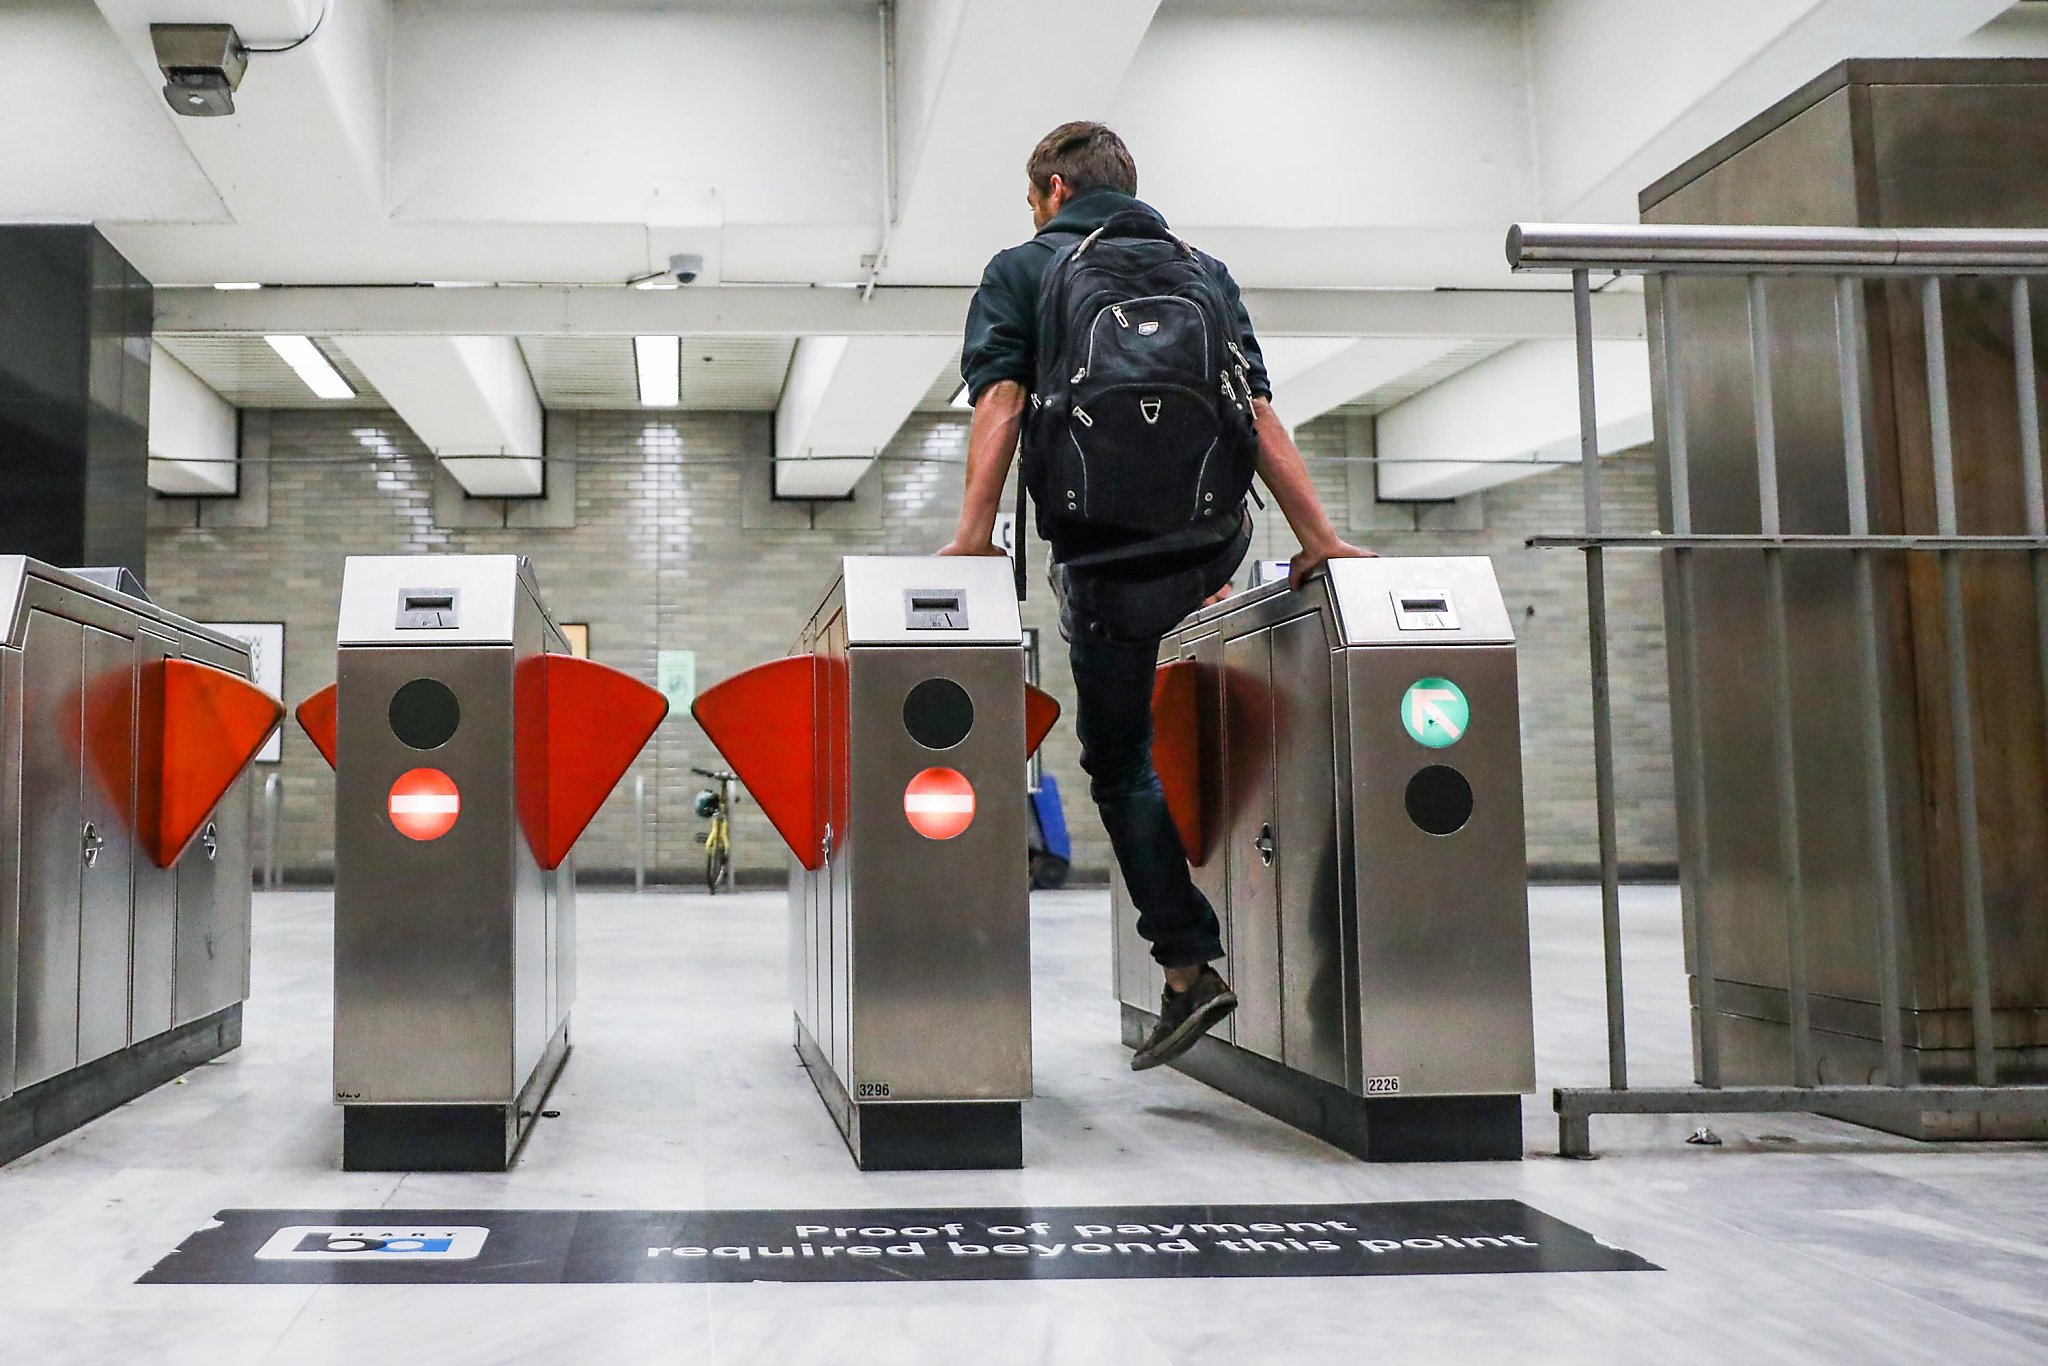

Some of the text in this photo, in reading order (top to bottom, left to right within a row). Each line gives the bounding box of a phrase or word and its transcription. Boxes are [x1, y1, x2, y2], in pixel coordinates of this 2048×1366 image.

[860, 1083, 889, 1096] 3296
[1369, 1078, 1398, 1092] 2226
[795, 1219, 1358, 1238] Proof of payment
[647, 1234, 1539, 1260] required beyond this point
